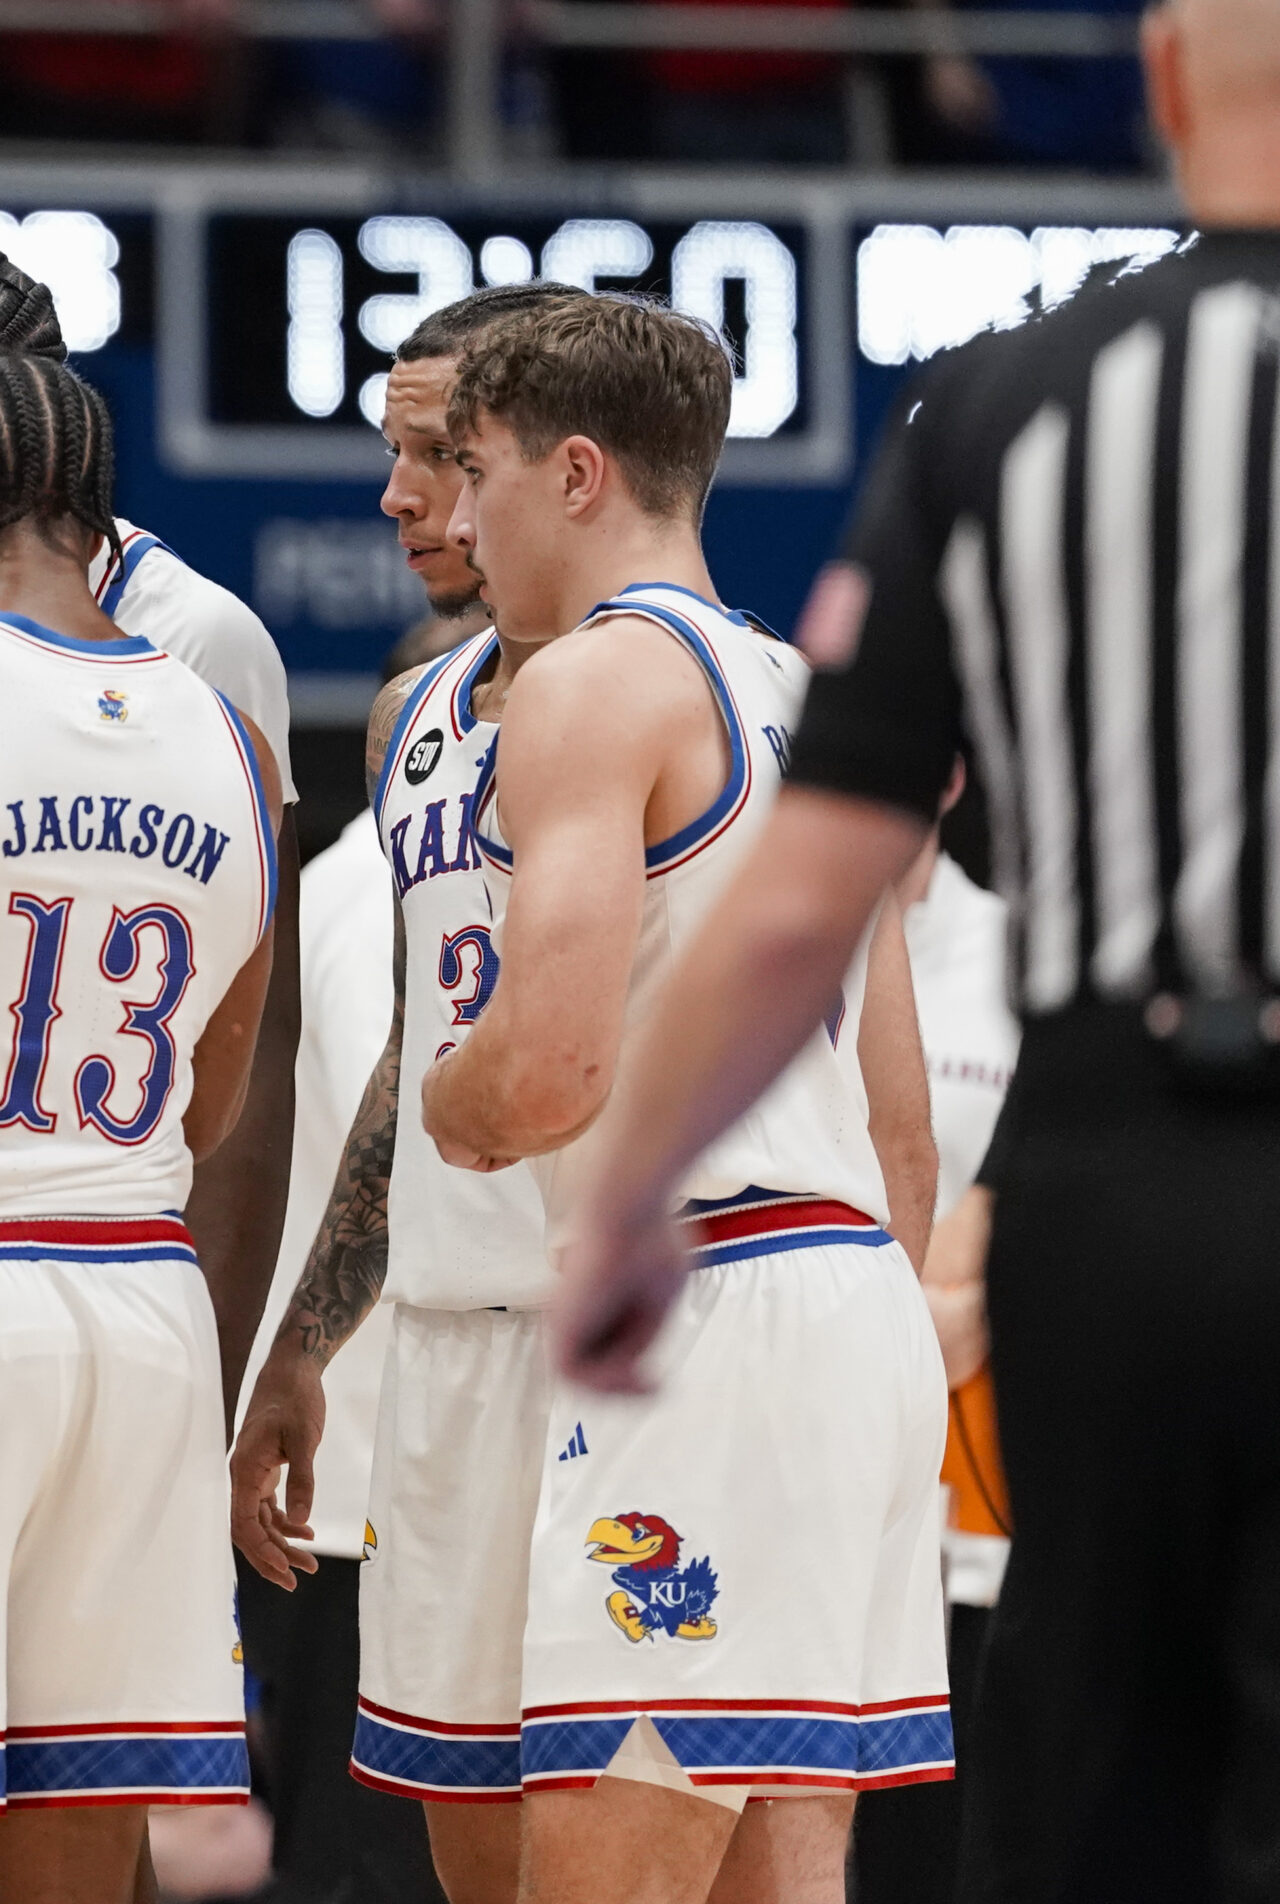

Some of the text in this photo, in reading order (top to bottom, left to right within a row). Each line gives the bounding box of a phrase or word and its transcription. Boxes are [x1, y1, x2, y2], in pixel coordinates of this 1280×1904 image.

[408, 741, 440, 772] SW
[2, 796, 231, 885] JACKSON
[648, 1582, 687, 1607] KU
